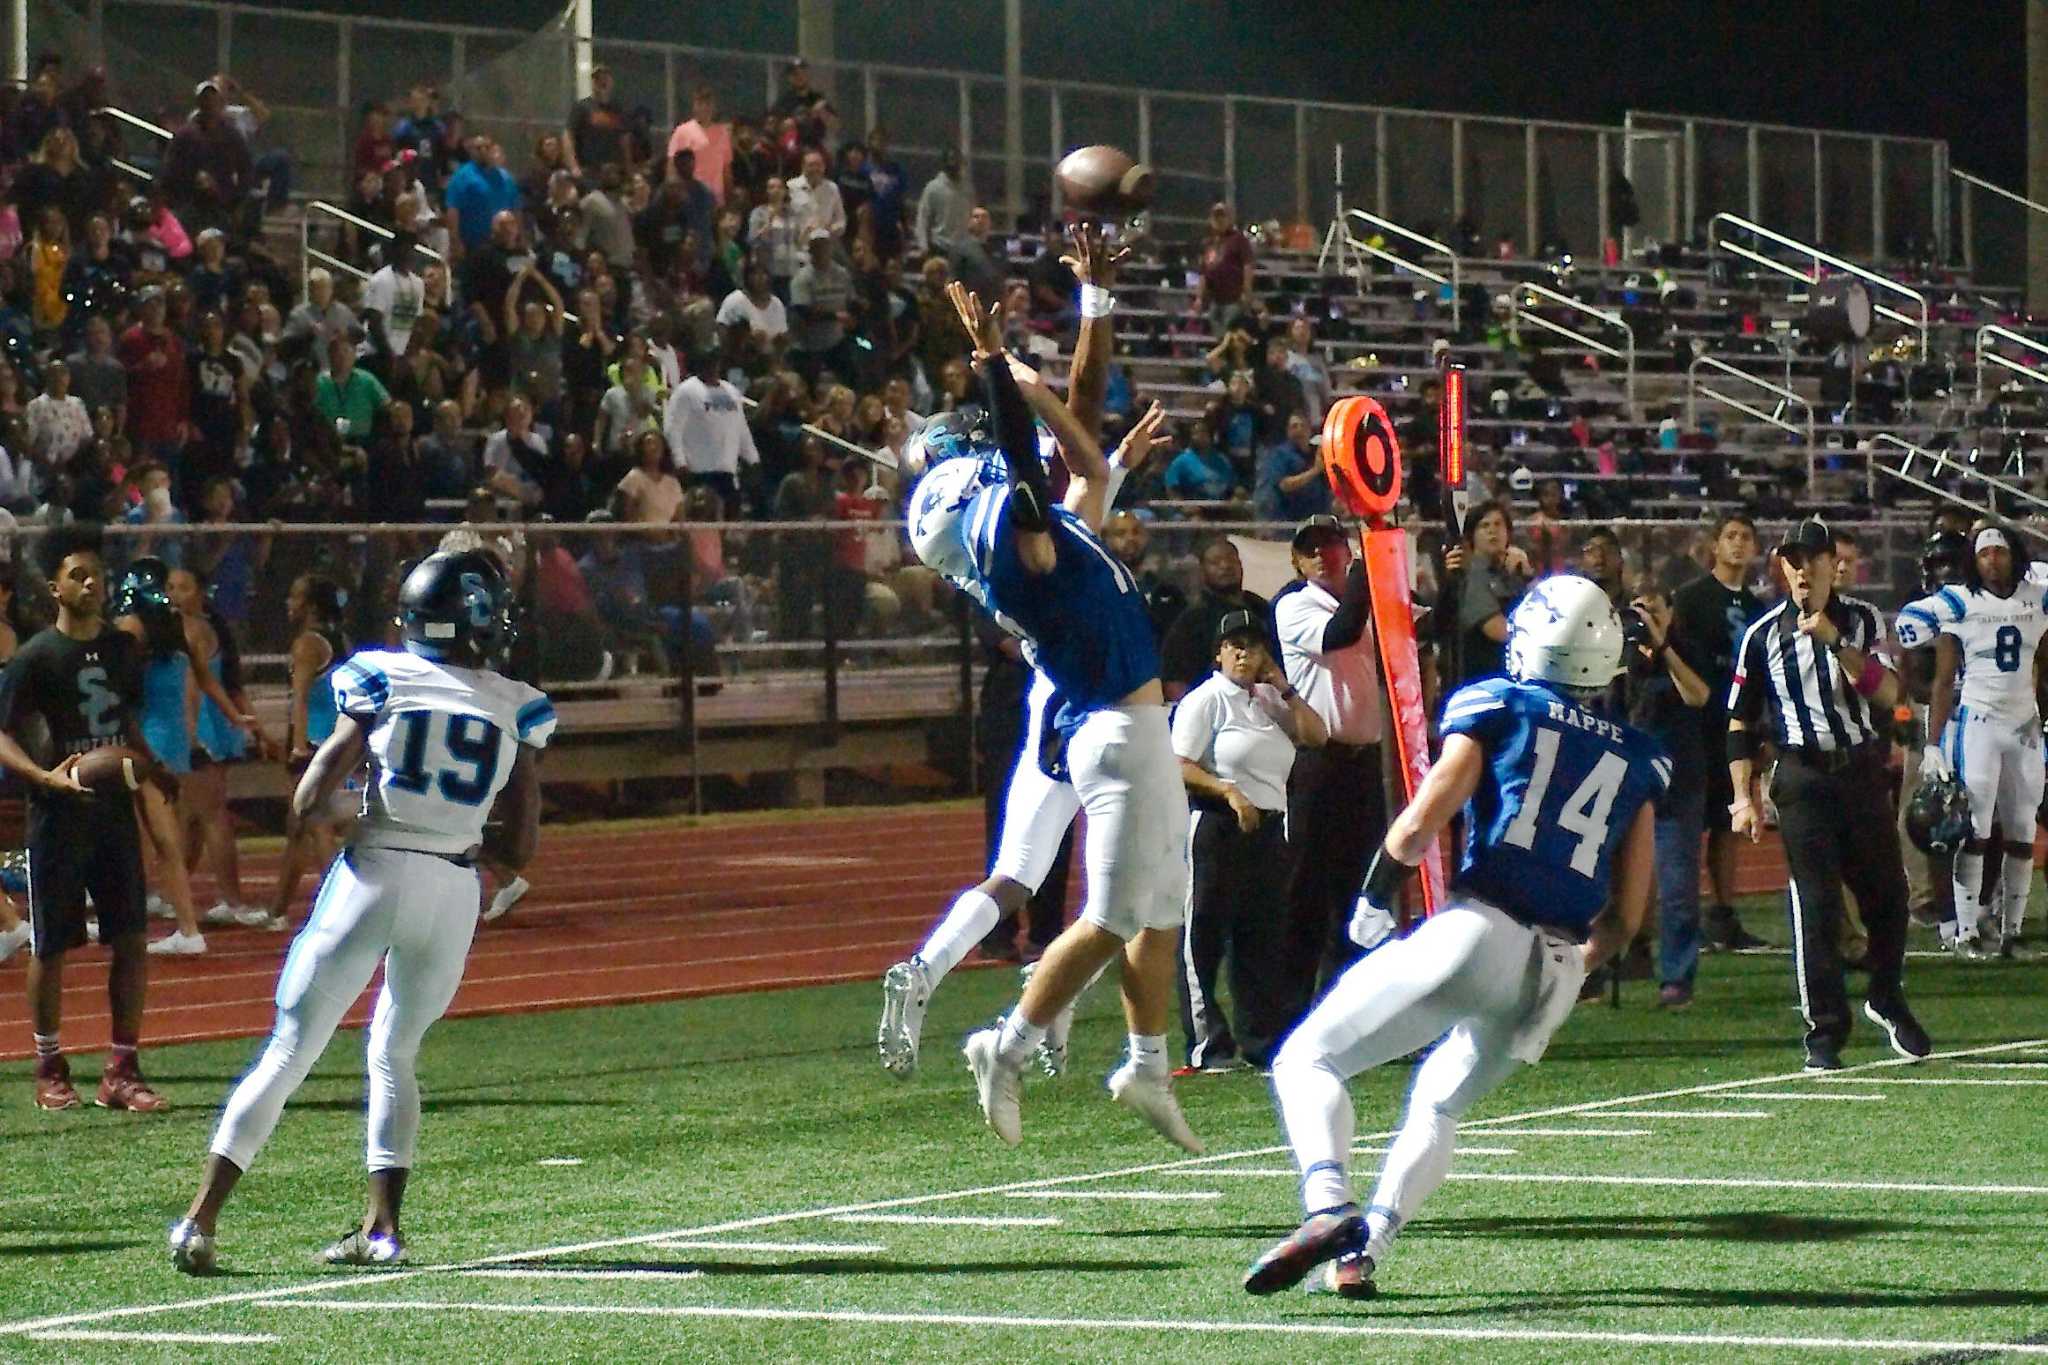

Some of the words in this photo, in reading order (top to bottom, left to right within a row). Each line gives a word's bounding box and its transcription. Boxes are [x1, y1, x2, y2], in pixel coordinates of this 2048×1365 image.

[1995, 625, 2023, 673] 8
[387, 709, 501, 807] 19
[1503, 726, 1629, 880] 14
